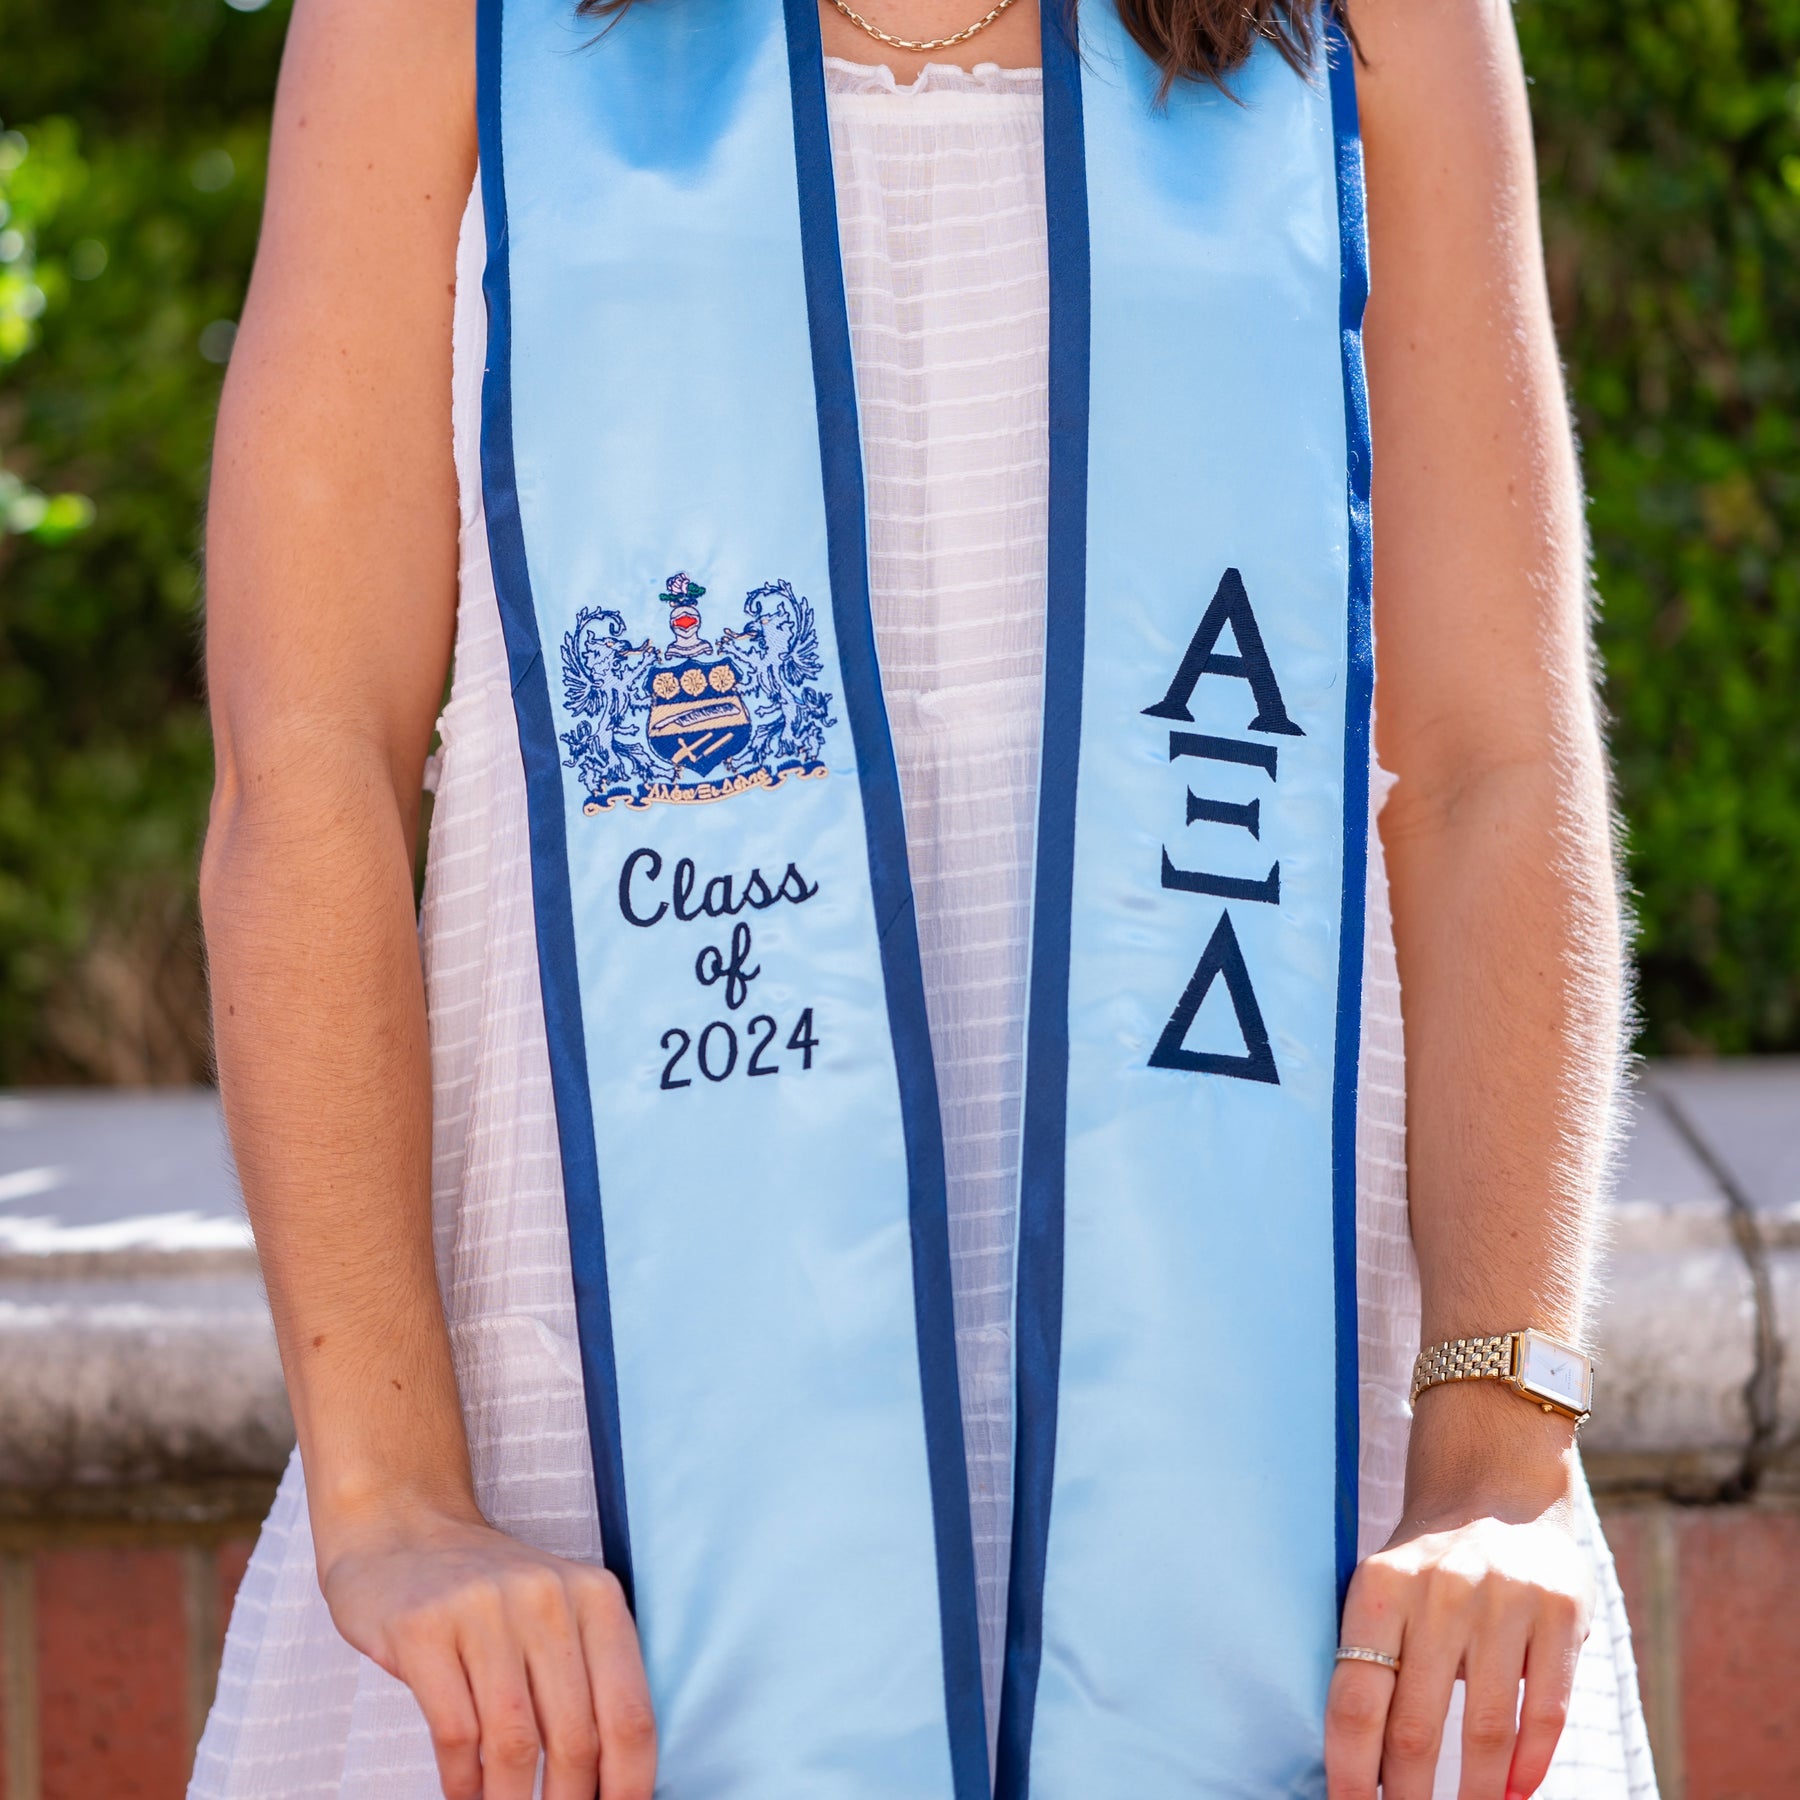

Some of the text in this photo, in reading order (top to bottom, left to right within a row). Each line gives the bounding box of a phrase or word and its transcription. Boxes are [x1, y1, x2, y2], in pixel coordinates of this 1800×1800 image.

[618, 847, 819, 928] Class
[694, 921, 761, 1011] of
[659, 1008, 820, 1091] 2024
